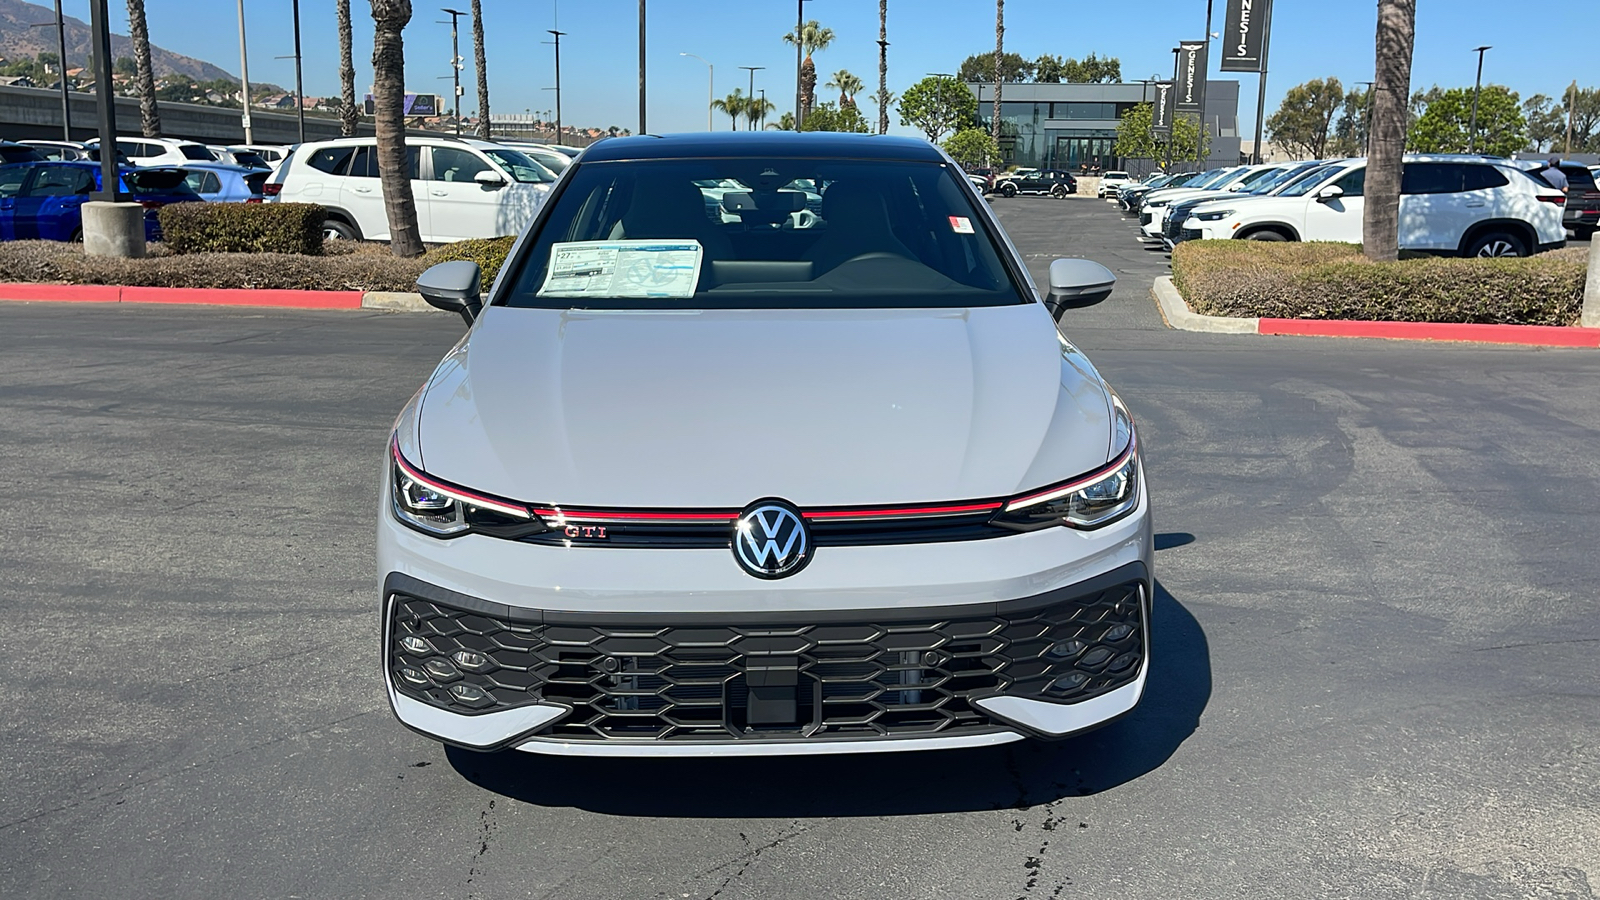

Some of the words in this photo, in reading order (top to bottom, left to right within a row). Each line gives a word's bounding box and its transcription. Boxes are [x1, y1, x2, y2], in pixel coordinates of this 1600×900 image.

[1185, 51, 1196, 102] GENESIS
[1158, 88, 1167, 126] GENESIS
[564, 525, 607, 538] GTI
